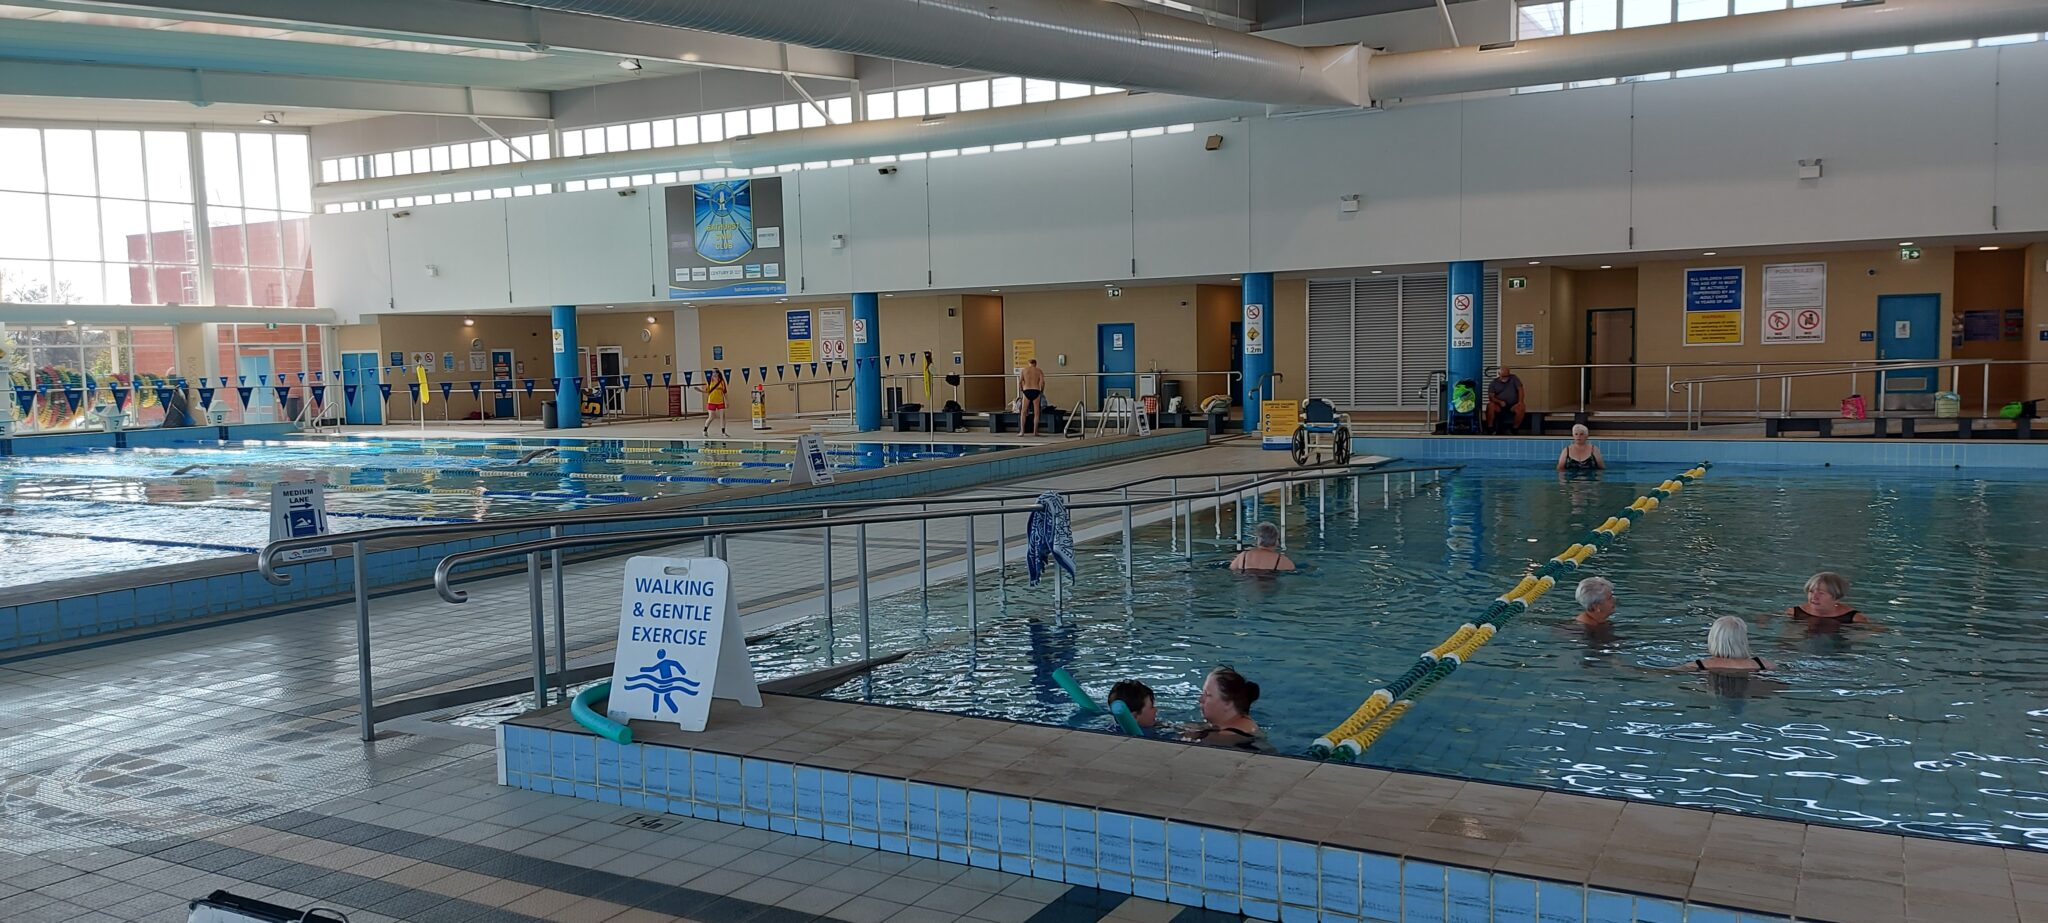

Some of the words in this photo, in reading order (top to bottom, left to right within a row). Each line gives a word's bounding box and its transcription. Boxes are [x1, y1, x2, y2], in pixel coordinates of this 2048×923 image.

[114, 420, 120, 430] 7
[282, 489, 314, 497] MEDIUM
[289, 496, 310, 504] LANE
[635, 577, 714, 597] WALKING
[632, 601, 644, 617] &
[650, 602, 712, 621] GENTLE
[631, 626, 708, 646] EXERCISE
